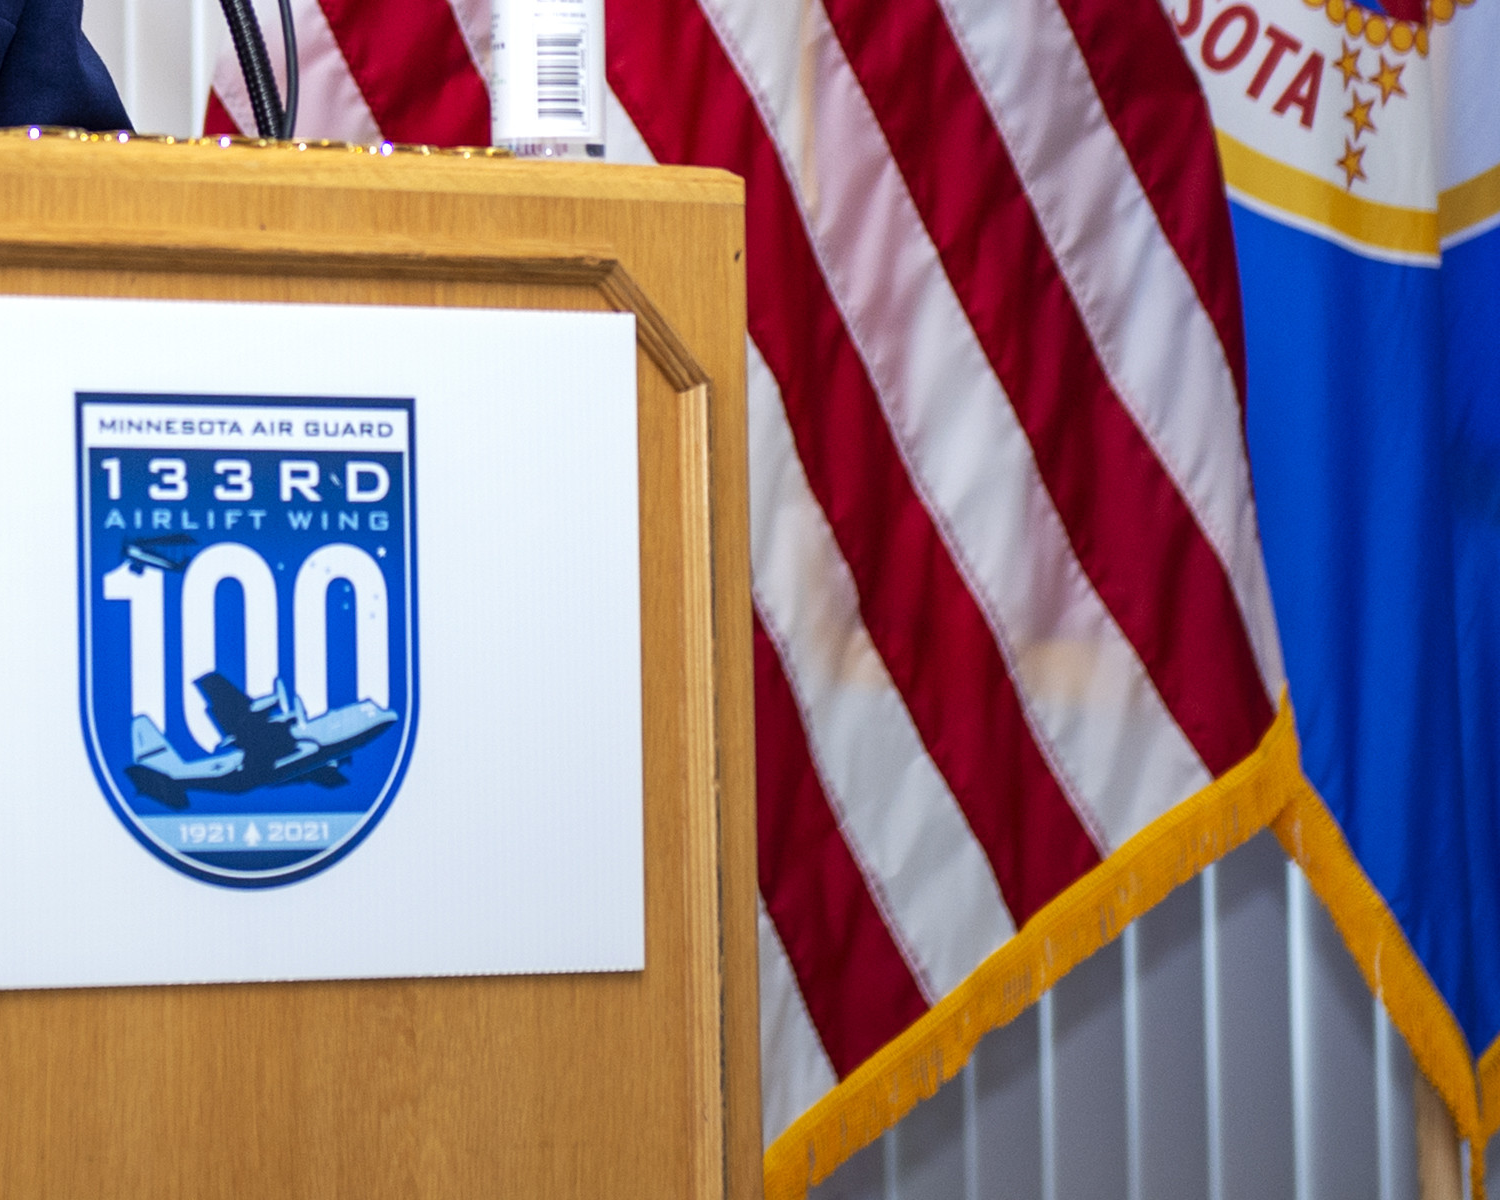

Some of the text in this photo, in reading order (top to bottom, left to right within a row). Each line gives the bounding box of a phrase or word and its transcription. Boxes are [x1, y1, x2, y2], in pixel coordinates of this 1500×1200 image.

[98, 418, 394, 438] MINNESOTA AIR GUARD
[101, 457, 391, 503] 133RD
[103, 508, 390, 531] AIRLIFT WING
[103, 542, 390, 754] 100
[179, 821, 330, 843] 1921 2021
